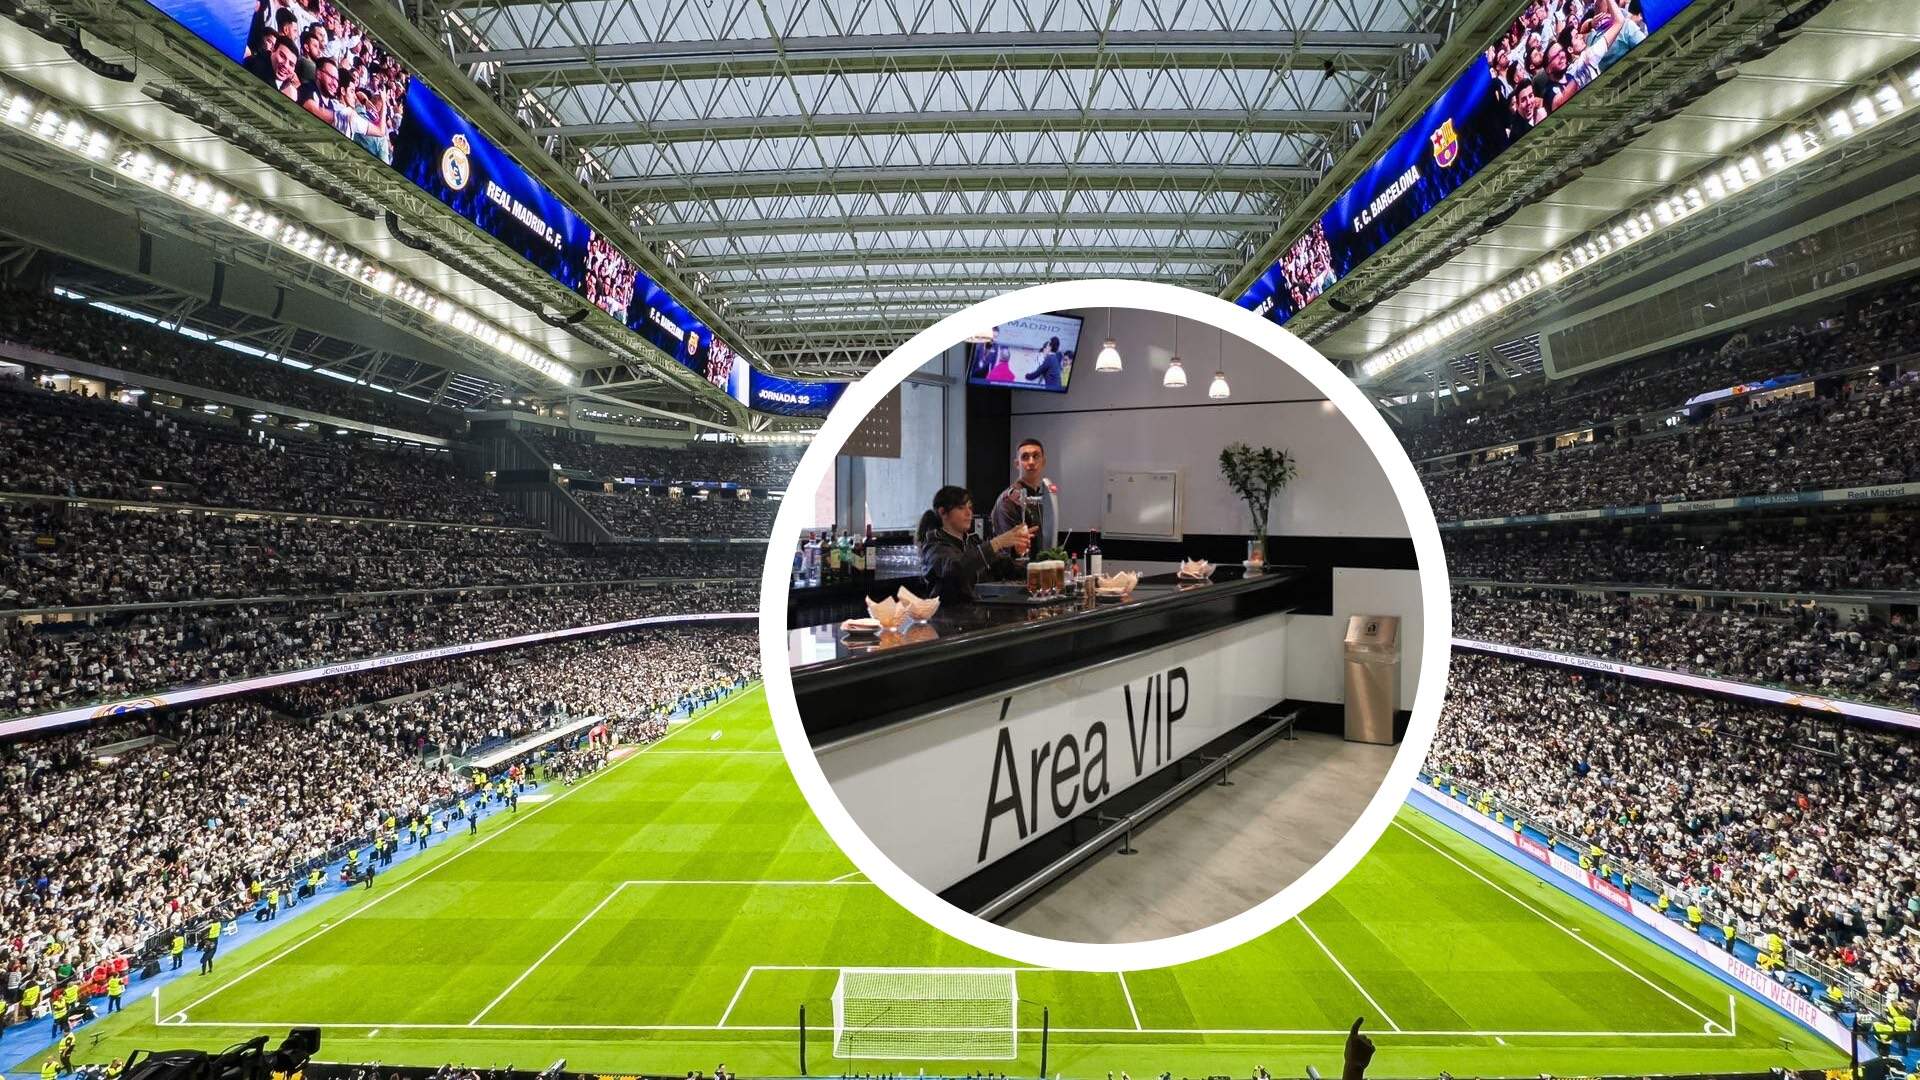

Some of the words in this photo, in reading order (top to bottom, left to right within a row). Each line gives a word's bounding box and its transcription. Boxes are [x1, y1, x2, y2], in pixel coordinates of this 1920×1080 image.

[1353, 217, 1363, 233] F.
[1361, 209, 1371, 225] C.
[1370, 165, 1420, 218] BARCELONA
[487, 180, 511, 212] REAL
[512, 200, 546, 236] MADRID
[545, 226, 554, 244] C.
[554, 233, 562, 250] F.
[1007, 319, 1061, 333] MADRID
[759, 389, 797, 404] JORNADA
[798, 395, 810, 405] 32
[1754, 497, 1771, 505] Real
[1772, 494, 1799, 504] Madrid
[1847, 490, 1868, 500] Real
[1870, 487, 1905, 498] Madrid
[322, 665, 352, 675] JORNADA
[1577, 658, 1614, 671] BARCELONA
[978, 697, 1110, 863] Área
[1123, 666, 1190, 777] VIP
[1728, 957, 1768, 993] PERFECT
[1771, 983, 1818, 1026] WEATHER
